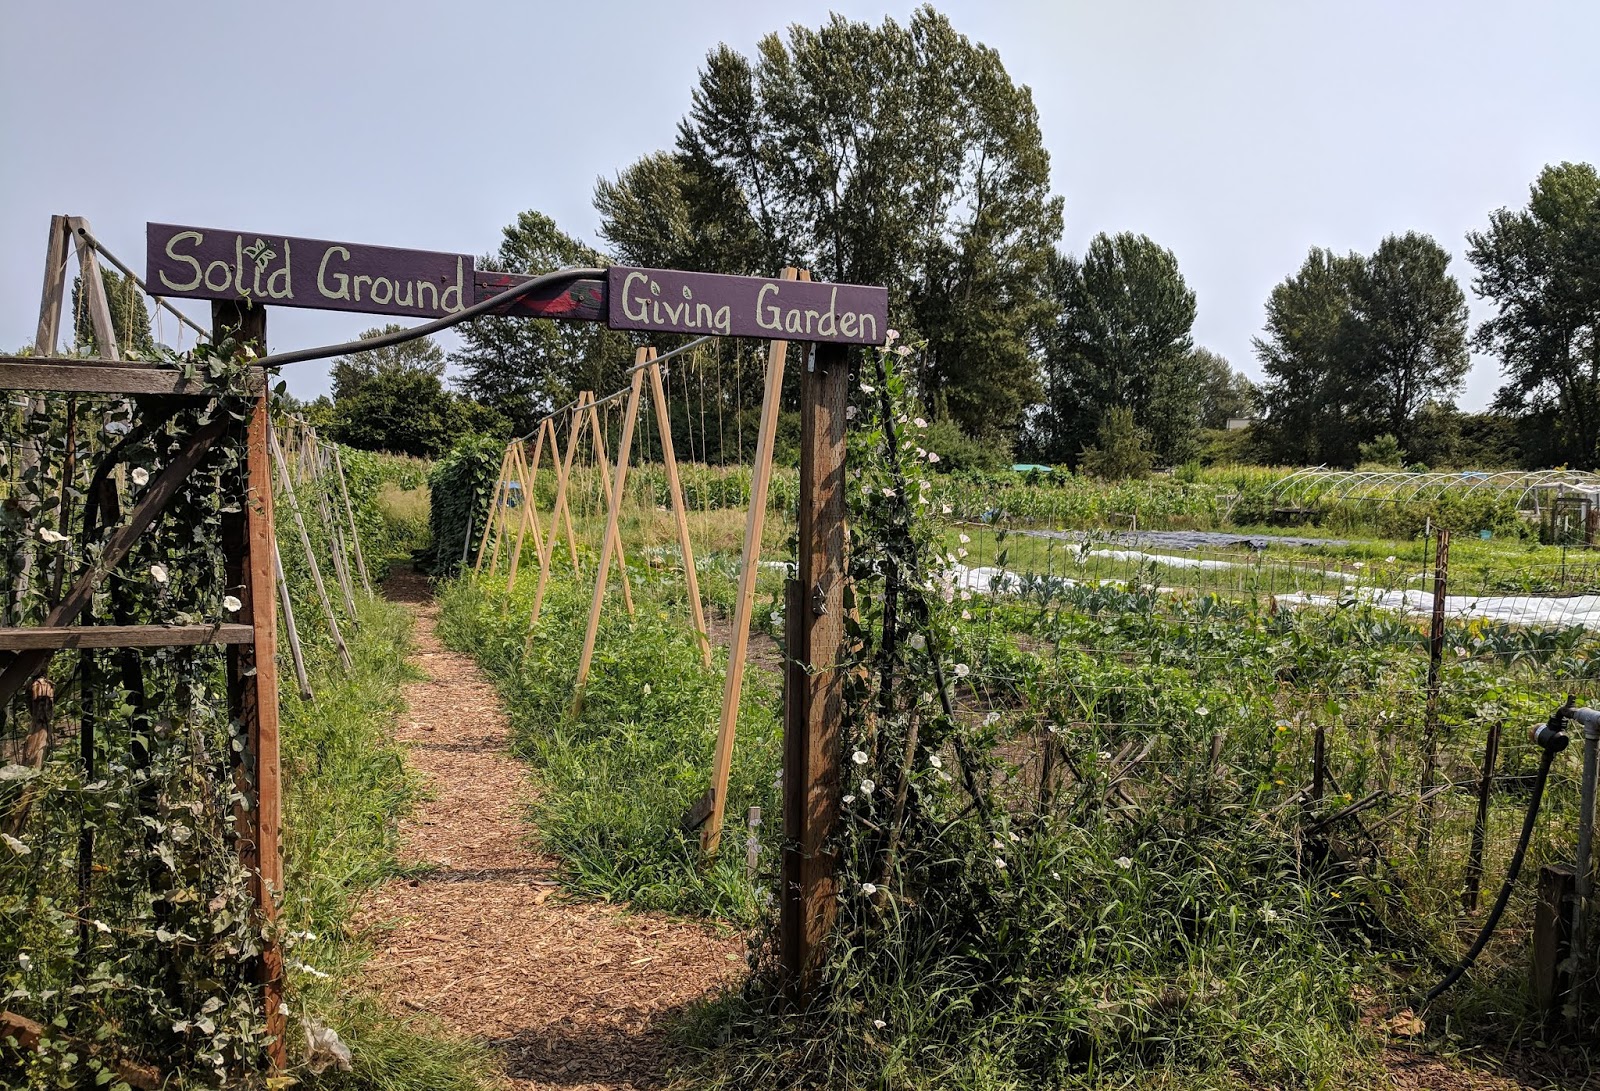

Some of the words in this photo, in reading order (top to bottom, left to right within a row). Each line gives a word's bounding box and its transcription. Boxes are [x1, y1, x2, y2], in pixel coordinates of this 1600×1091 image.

[159, 231, 294, 300] Solid
[317, 246, 466, 313] Ground
[621, 271, 731, 336] Giving
[755, 283, 877, 340] Garden
